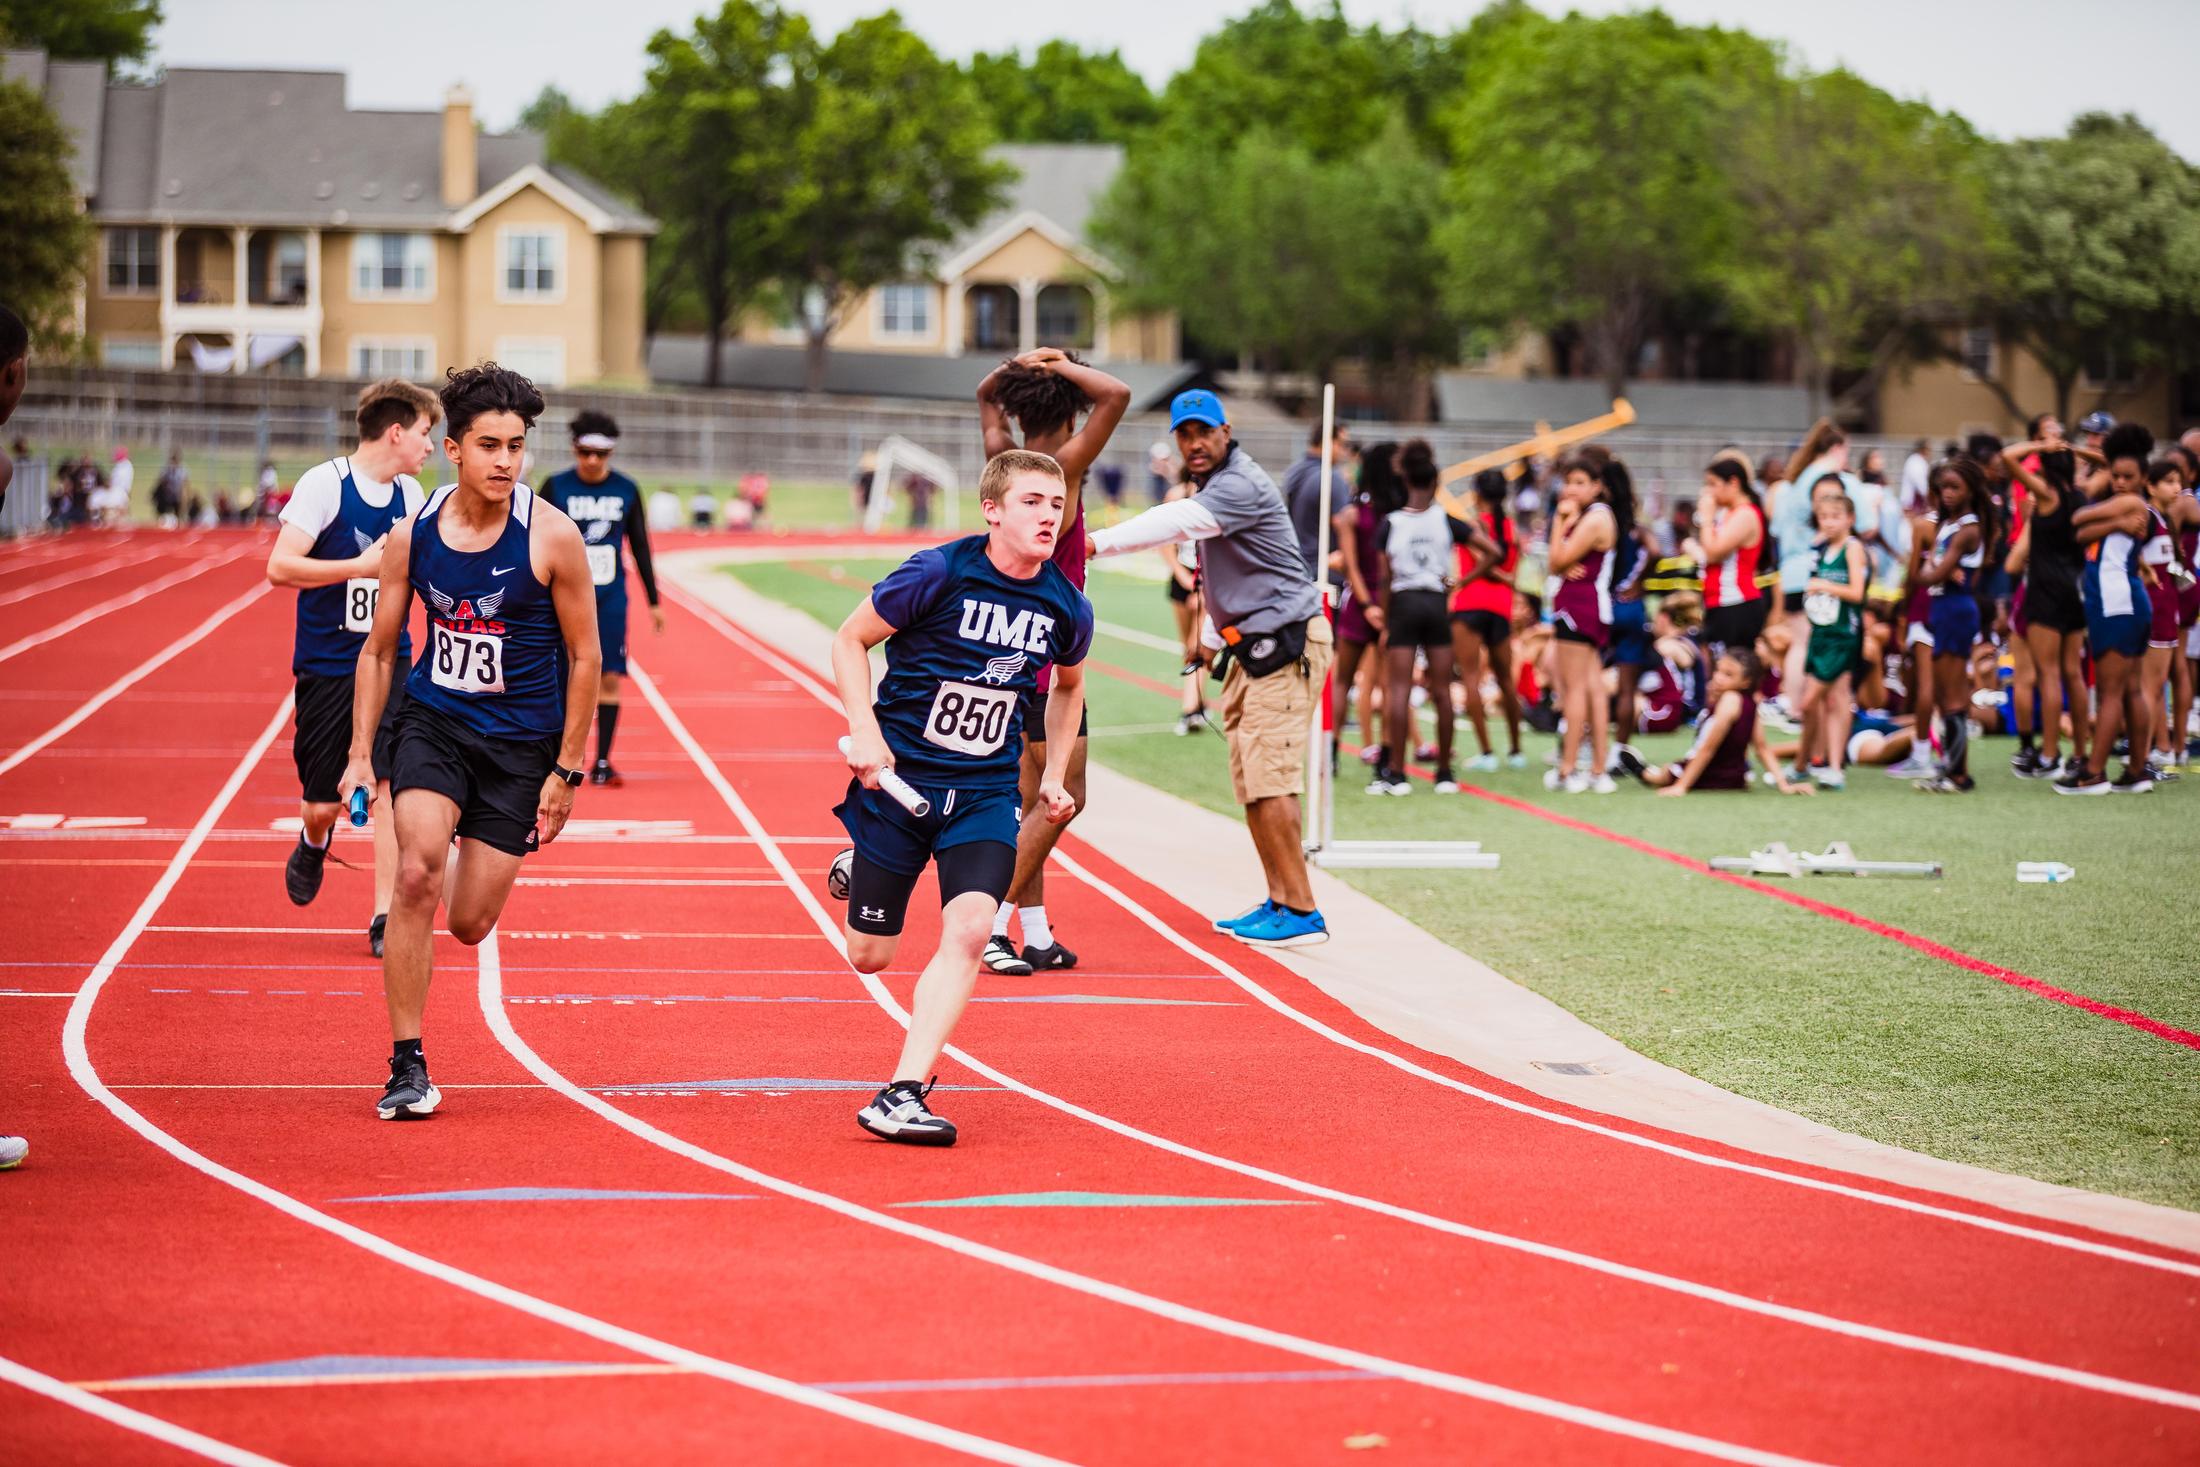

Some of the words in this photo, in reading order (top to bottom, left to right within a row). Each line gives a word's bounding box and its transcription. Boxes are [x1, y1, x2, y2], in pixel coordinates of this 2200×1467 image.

[567, 496, 624, 521] UME
[455, 600, 475, 619] A
[958, 599, 1055, 654] UME
[438, 630, 496, 684] 873
[934, 692, 1008, 744] 850
